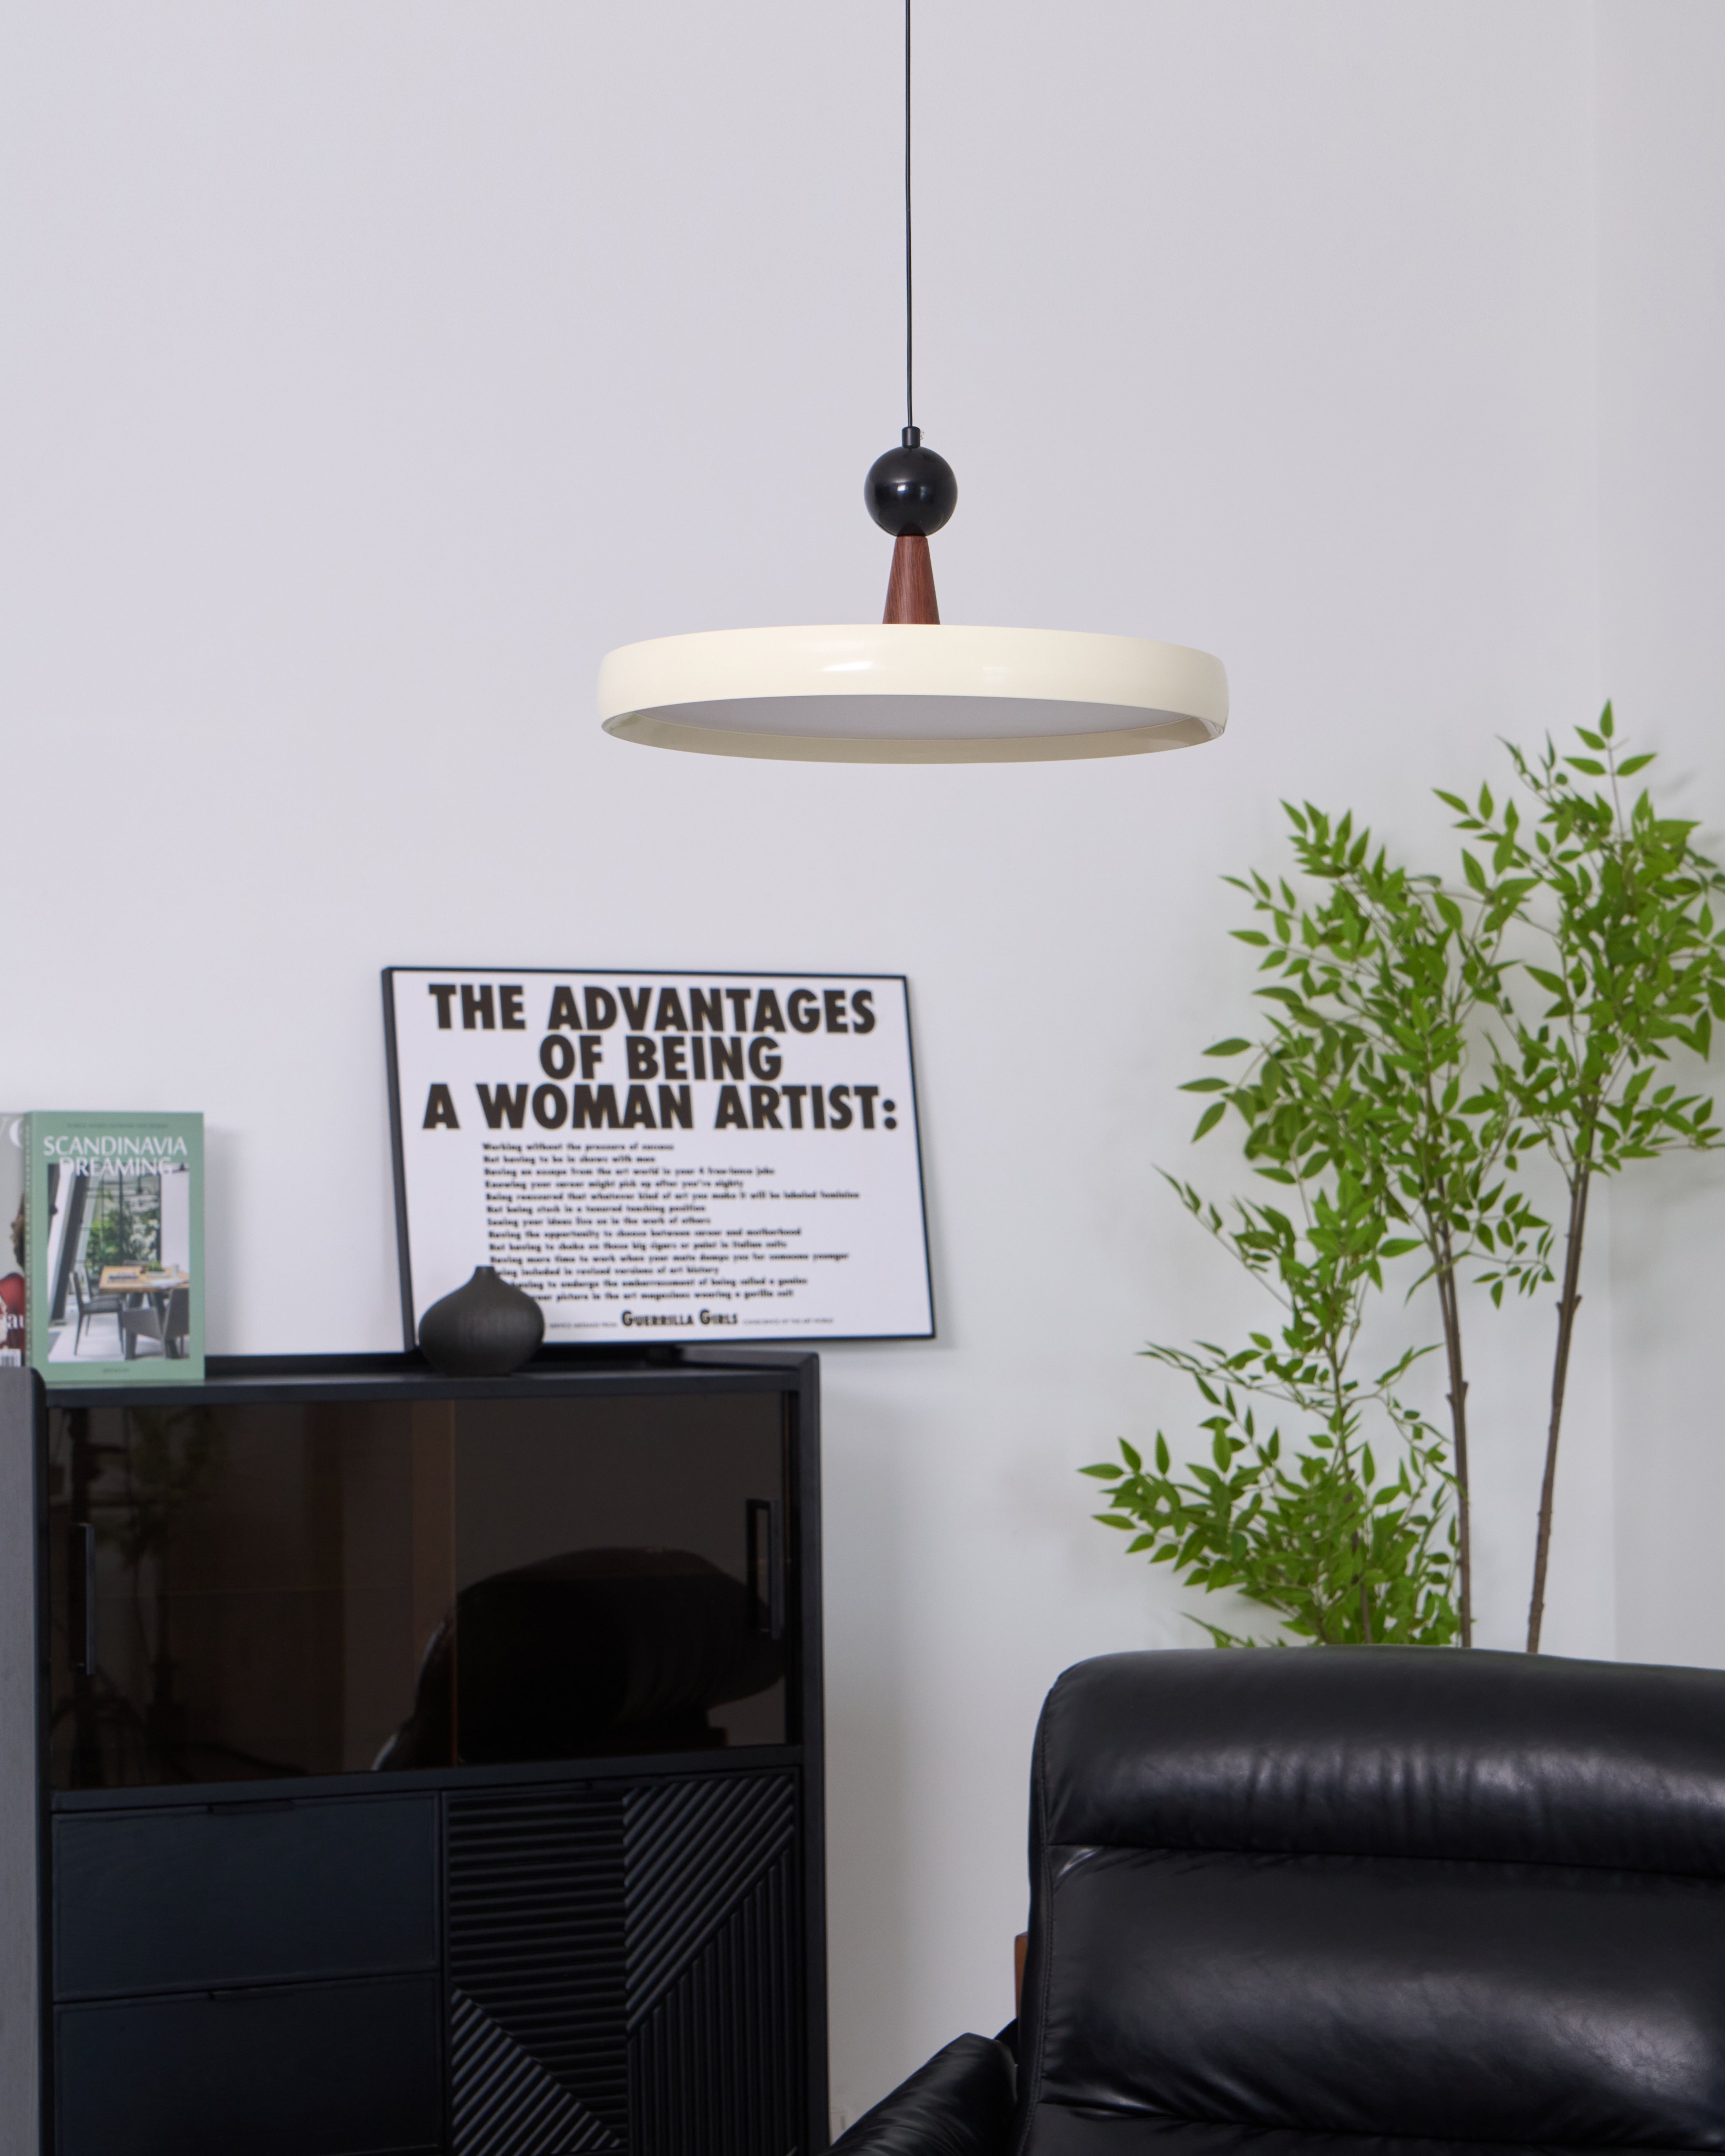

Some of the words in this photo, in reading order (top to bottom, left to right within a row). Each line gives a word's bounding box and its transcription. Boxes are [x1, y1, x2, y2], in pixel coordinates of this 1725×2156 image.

[428, 983, 526, 1030] THE
[547, 985, 876, 1035] ADVANTAGES
[539, 1033, 603, 1081] OF
[625, 1035, 782, 1082] BEING
[422, 1083, 460, 1130] A
[475, 1083, 694, 1130] WOMAN
[714, 1084, 897, 1130] ARTIST:
[43, 1135, 188, 1156] SCANDINAVIA
[60, 1156, 171, 1177] DREAMING
[621, 1310, 693, 1326] GUERRILLA
[699, 1308, 738, 1325] GIRLS
